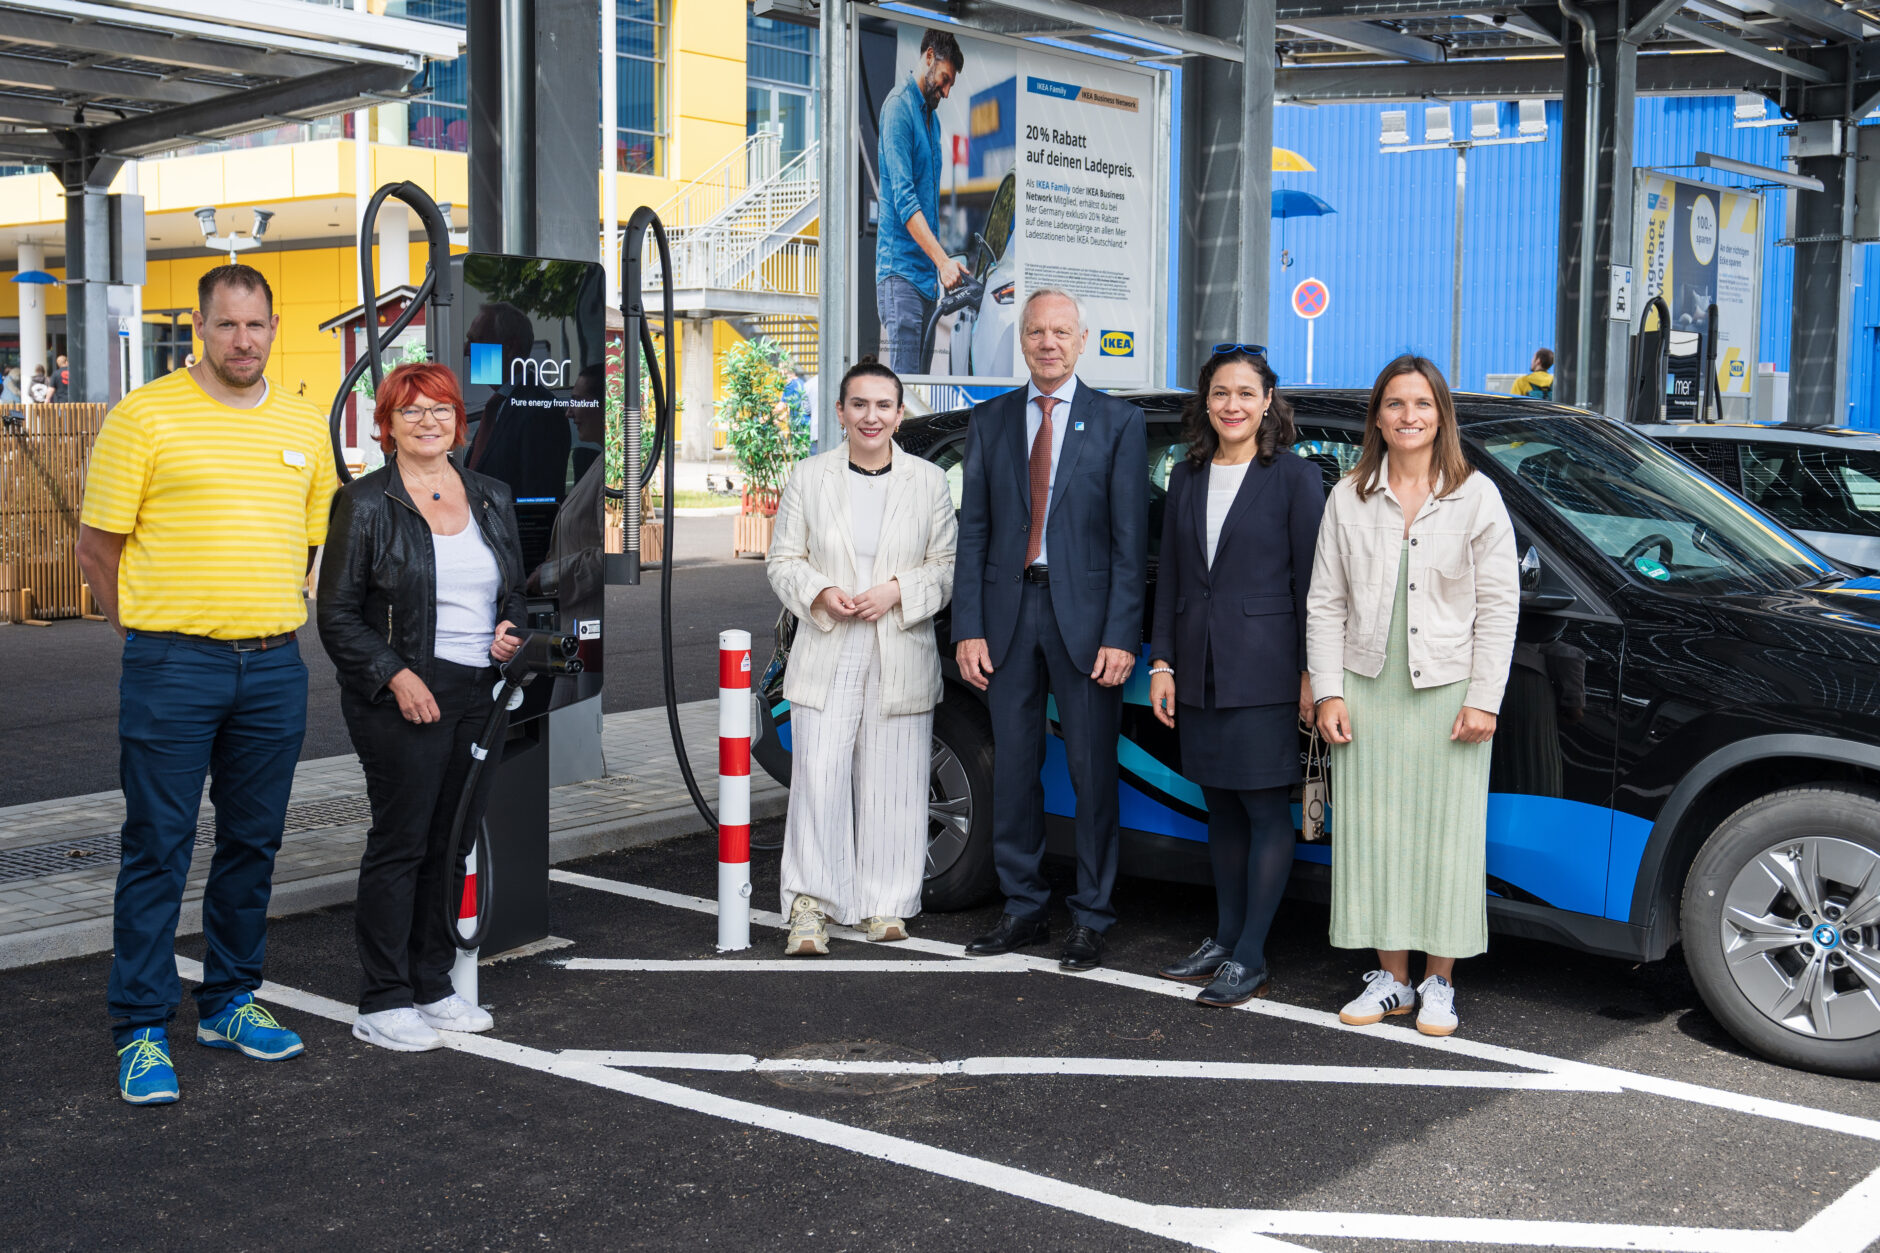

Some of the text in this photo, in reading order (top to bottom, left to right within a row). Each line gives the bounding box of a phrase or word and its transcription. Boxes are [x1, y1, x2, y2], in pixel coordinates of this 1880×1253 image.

[1036, 82, 1067, 96] IKEA Family
[1081, 91, 1137, 109] IKEA Business Network
[1052, 129, 1087, 149] Rabatt
[1026, 149, 1135, 179] auf deinen Ladepreis.
[1026, 178, 1125, 200] Als IKEA Family oder IKEA Business
[1025, 191, 1052, 203] Network
[1100, 201, 1108, 210] du
[1108, 202, 1118, 212] bei
[1025, 204, 1037, 214] Mer
[1038, 205, 1065, 218] Germany
[1065, 209, 1088, 219] exklusiv
[1101, 213, 1119, 224] Rabatt
[1025, 217, 1036, 226] auf
[1036, 218, 1053, 228] deine
[1053, 220, 1093, 235] Ladevorgänge
[1101, 225, 1114, 235] allen
[1115, 227, 1127, 236] Mer
[1025, 229, 1066, 242] Ladestationen
[1066, 234, 1076, 243] bei
[1076, 235, 1090, 245] IKEA
[1103, 338, 1131, 349] IKEA
[510, 357, 572, 387] mer
[1674, 380, 1692, 395] mer
[510, 398, 599, 409] Pure energy from Statkraft
